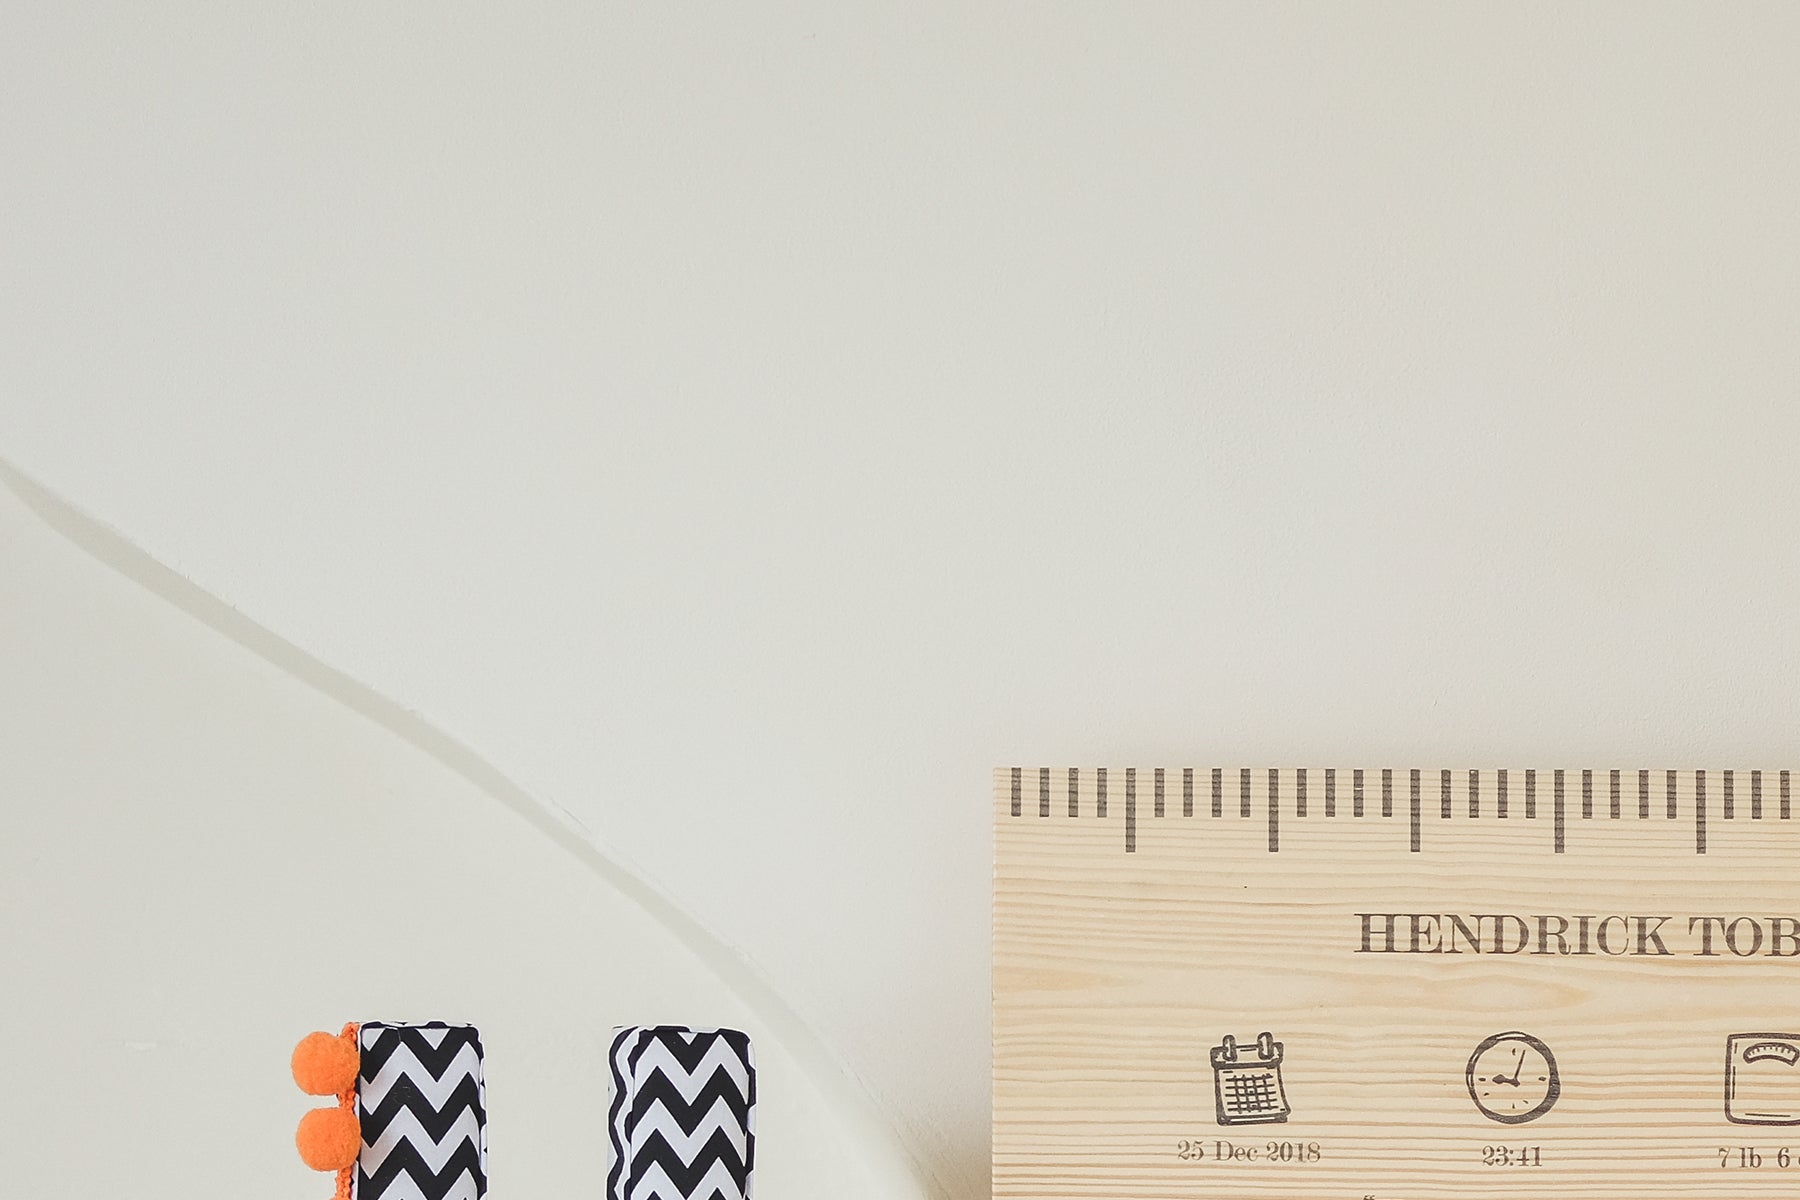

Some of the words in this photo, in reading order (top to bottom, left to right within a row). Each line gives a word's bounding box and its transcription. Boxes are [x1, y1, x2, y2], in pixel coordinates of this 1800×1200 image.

[1353, 912, 1675, 956] HENDRICK
[1177, 1139, 1205, 1162] 25
[1212, 1139, 1260, 1162] Dec
[1266, 1140, 1321, 1163] 2018
[1482, 1144, 1543, 1168] 23:41
[1717, 1146, 1731, 1169] 7
[1738, 1145, 1763, 1169] lb
[1777, 1146, 1791, 1169] 6
